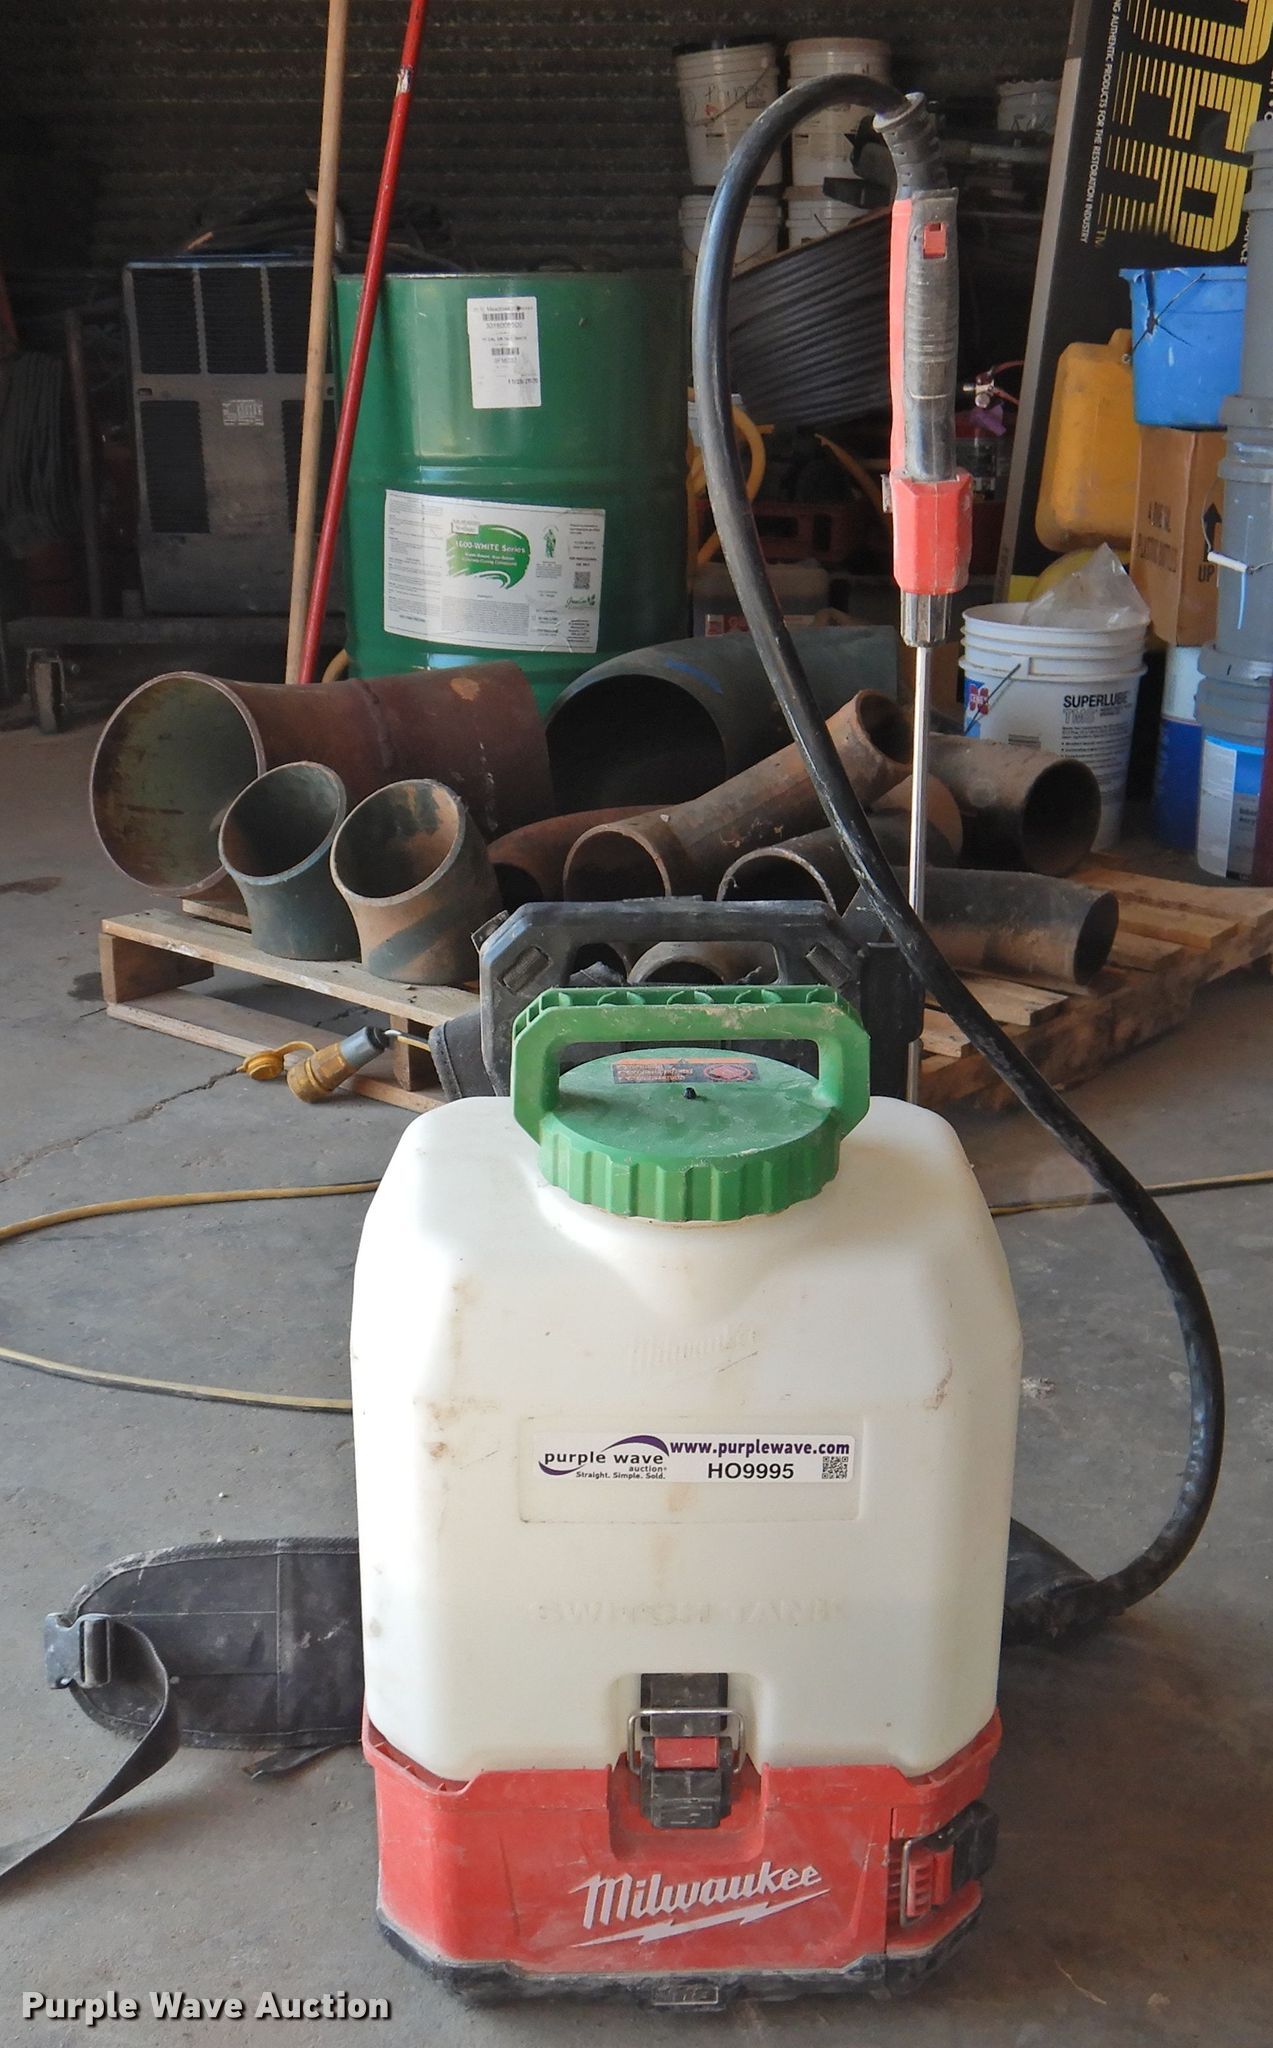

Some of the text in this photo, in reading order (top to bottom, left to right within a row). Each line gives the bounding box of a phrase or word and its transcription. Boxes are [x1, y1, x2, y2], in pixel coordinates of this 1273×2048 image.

[1105, 14, 1120, 62] AUTHENTIC
[1099, 64, 1113, 108] PRODUCTS
[1096, 110, 1107, 128] FOR
[1093, 129, 1104, 144] THE
[1086, 145, 1101, 202] RESTORATION
[1080, 203, 1093, 243] INDUSTRY
[1198, 565, 1215, 583] UP
[669, 1438, 850, 1458] www.purplewave.com
[544, 1450, 664, 1466] purple wave
[575, 1471, 666, 1480] Straight. Simple. Sold.
[629, 1465, 664, 1473] auction
[707, 1462, 794, 1479] HO9995
[568, 1861, 822, 1930] Milwaukee
